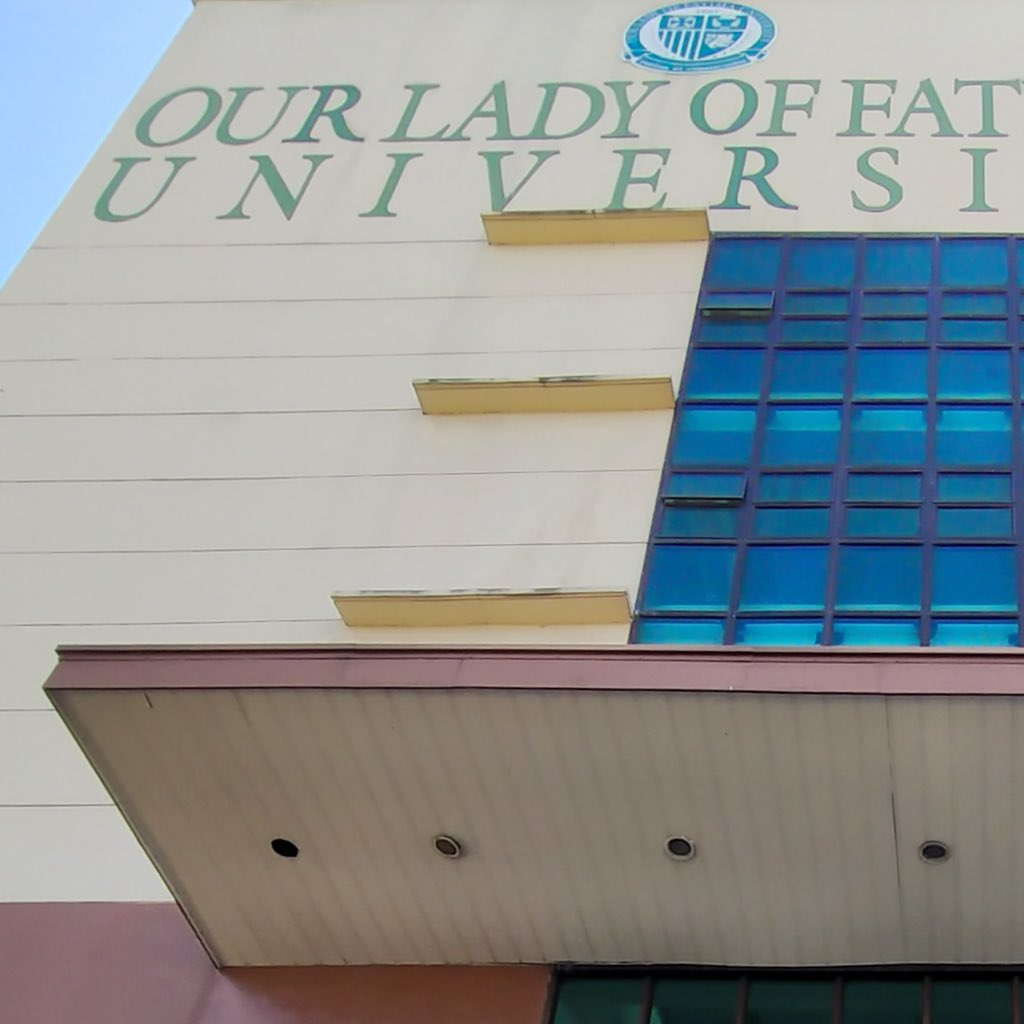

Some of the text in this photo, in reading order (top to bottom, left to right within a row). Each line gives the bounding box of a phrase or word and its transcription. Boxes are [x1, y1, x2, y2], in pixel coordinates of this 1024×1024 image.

[134, 83, 366, 149] OUR
[379, 79, 671, 142] LADY
[689, 78, 822, 138] OF
